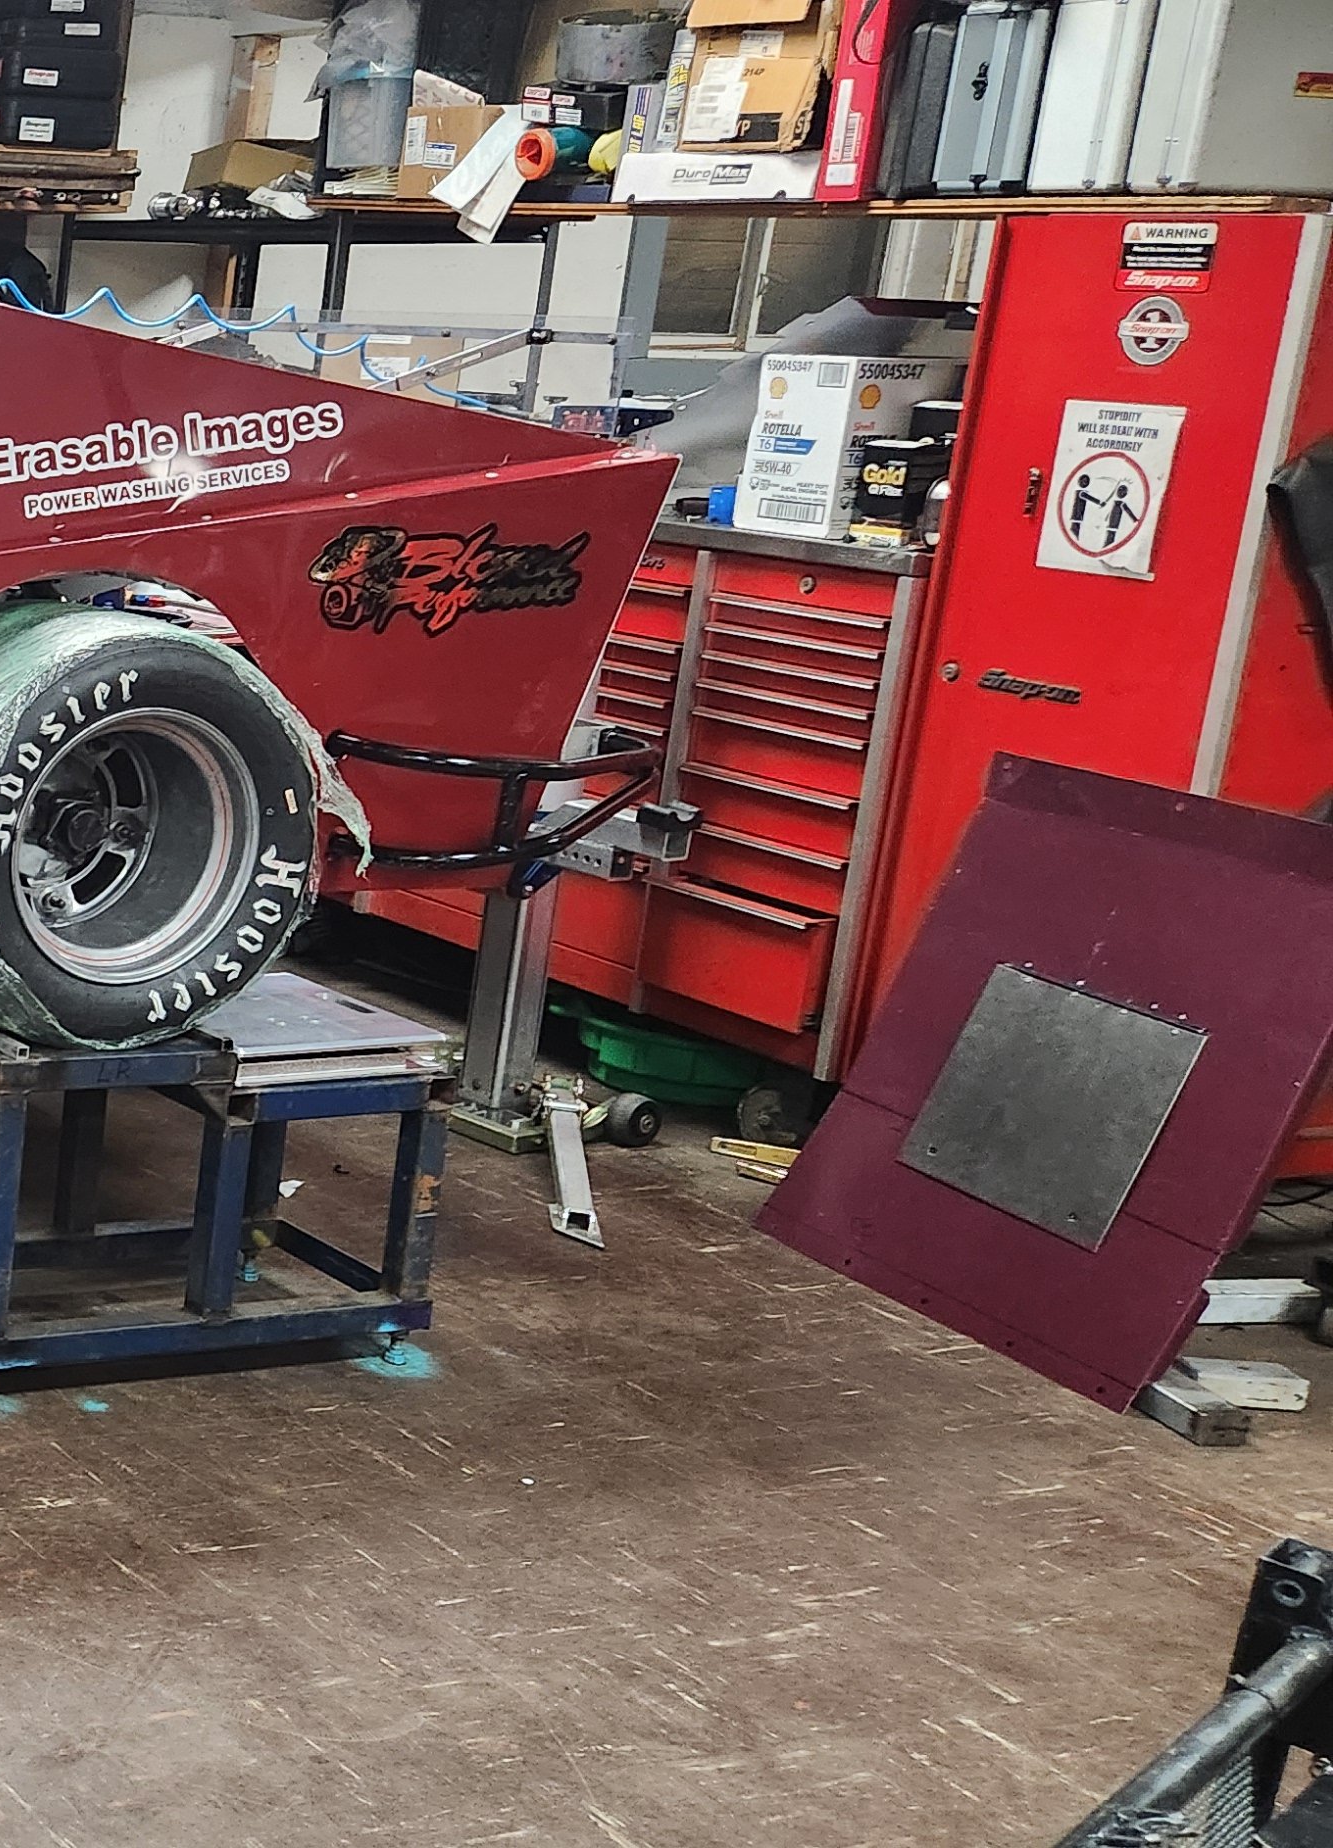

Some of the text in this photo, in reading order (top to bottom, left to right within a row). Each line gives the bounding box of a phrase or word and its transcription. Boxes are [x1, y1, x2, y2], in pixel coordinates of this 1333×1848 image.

[672, 164, 751, 180] Duro Max
[1145, 228, 1210, 239] WARNING
[1124, 271, 1200, 289] Snap-on
[1128, 323, 1177, 334] Snap-on
[767, 359, 814, 373] 550045347
[858, 363, 926, 381] 550045347
[1097, 409, 1143, 423] STUPIDITY
[186, 402, 342, 455] Images
[761, 422, 803, 437] ROTELLA
[1077, 422, 1098, 434] WILL
[1099, 424, 1110, 435] BE
[1133, 427, 1160, 440] WITH
[759, 438, 772, 450] T6
[1085, 437, 1143, 453] ACCORDINGLY
[863, 463, 907, 486] Gold
[26, 462, 288, 517] POWER WASHING SERVICES
[978, 667, 1082, 705] Snap-on
[146, 844, 306, 1024] Hoosier
